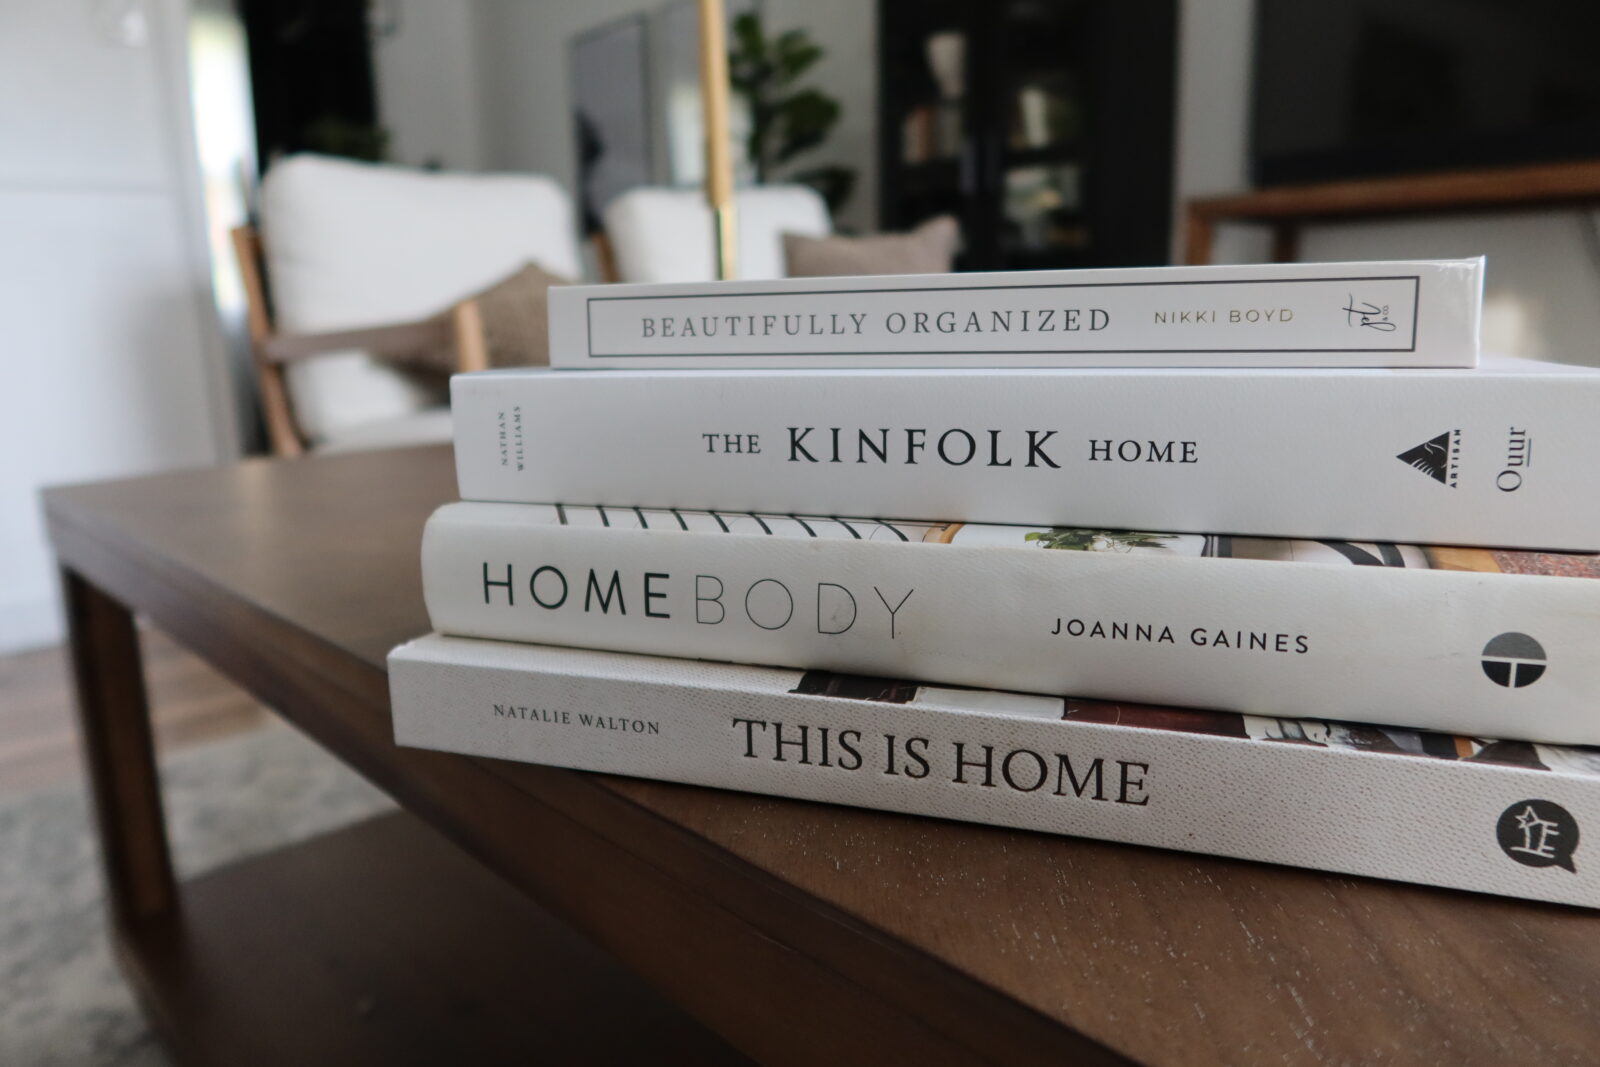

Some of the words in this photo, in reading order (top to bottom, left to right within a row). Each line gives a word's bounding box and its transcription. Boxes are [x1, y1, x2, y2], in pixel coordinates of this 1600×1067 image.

[641, 313, 868, 338] BEAUTIFULLY
[885, 308, 1110, 335] ORGANIZED
[1154, 310, 1216, 324] NIKKI
[1229, 308, 1294, 323] BOYD
[498, 411, 508, 467] NATHAN
[513, 405, 524, 472] WILLIAMS
[702, 433, 762, 455] THE
[786, 426, 1063, 469] KINFOLK
[1088, 439, 1199, 464] HOME
[1450, 429, 1461, 489] ARTISAN
[1496, 426, 1527, 492] Ouur
[482, 562, 914, 639] HOMEBODY
[1051, 618, 1176, 644] JOANNA
[1190, 628, 1310, 655] GAINES
[493, 703, 572, 725] NATALIE
[578, 713, 660, 735] WALTON
[732, 717, 863, 771] THIS
[883, 734, 930, 779] IS
[952, 742, 1151, 807] HOME
